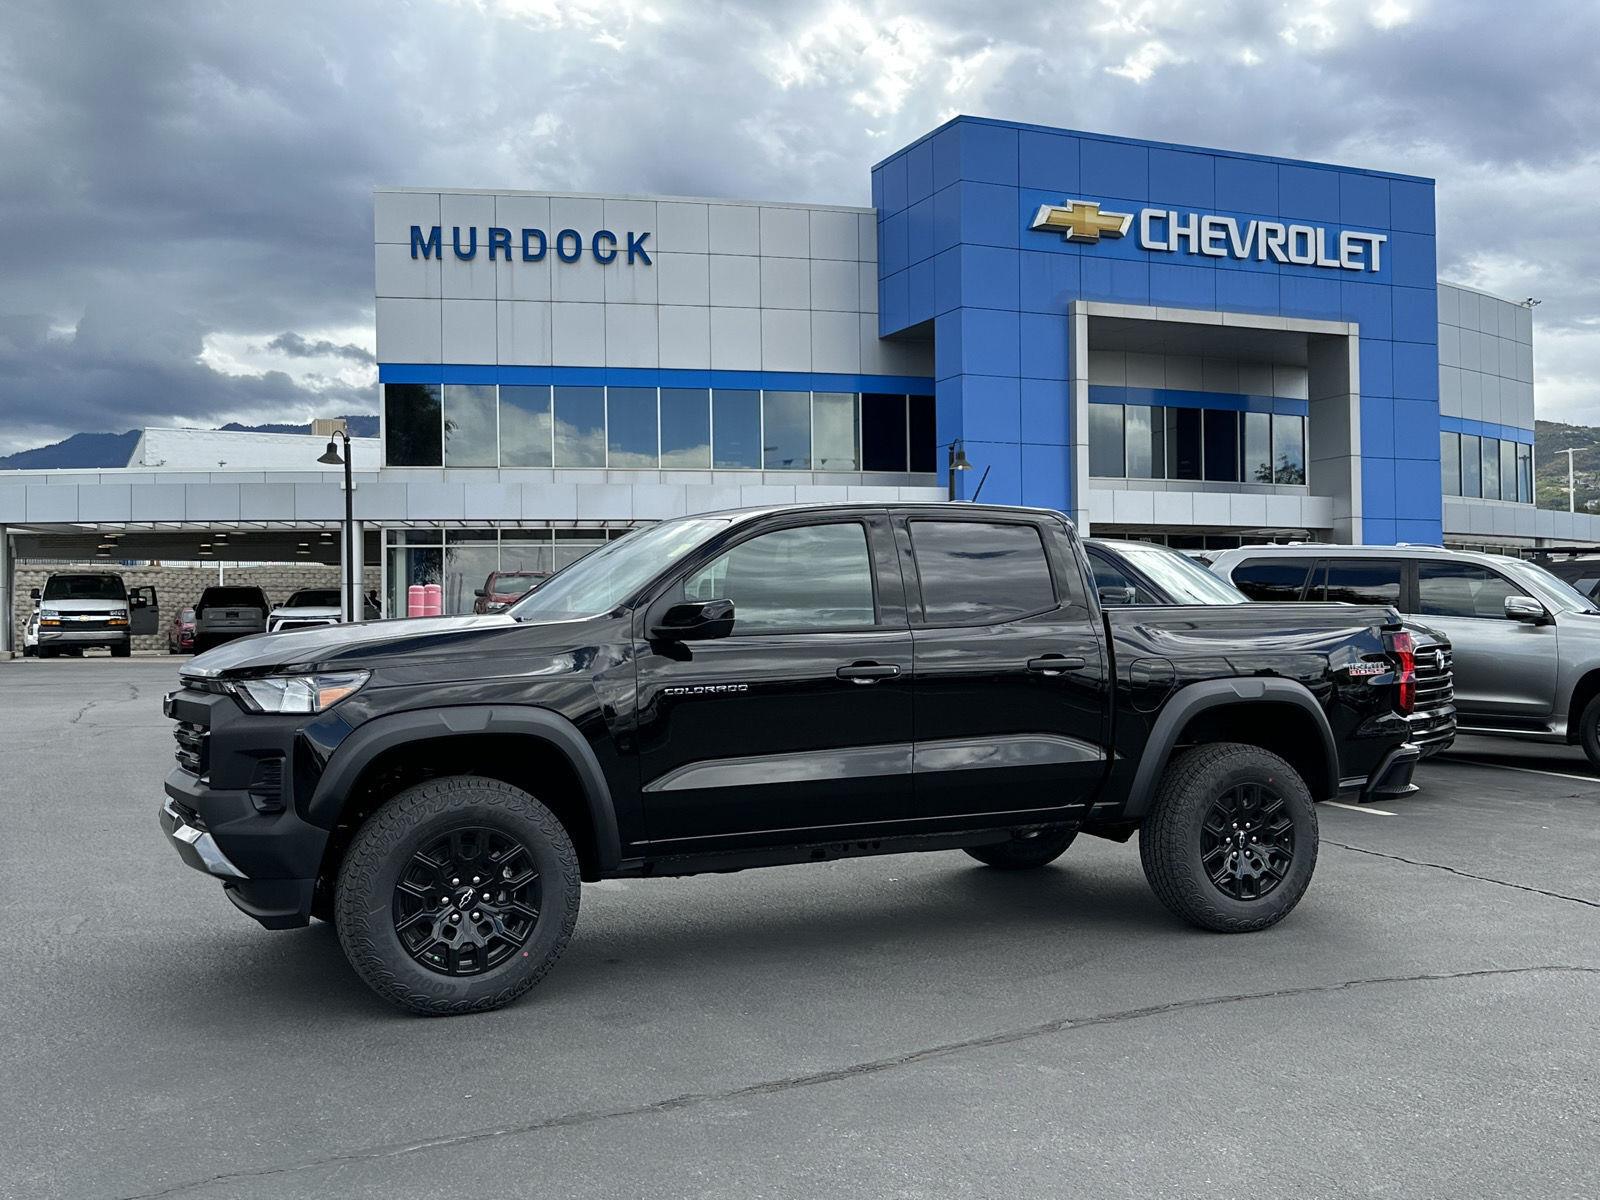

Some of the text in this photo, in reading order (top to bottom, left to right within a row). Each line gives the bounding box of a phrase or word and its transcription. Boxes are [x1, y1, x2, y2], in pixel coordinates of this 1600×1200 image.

[410, 225, 653, 266] MURDOCK
[1139, 207, 1388, 272] CHEVROLET
[664, 684, 748, 695] COLORADO
